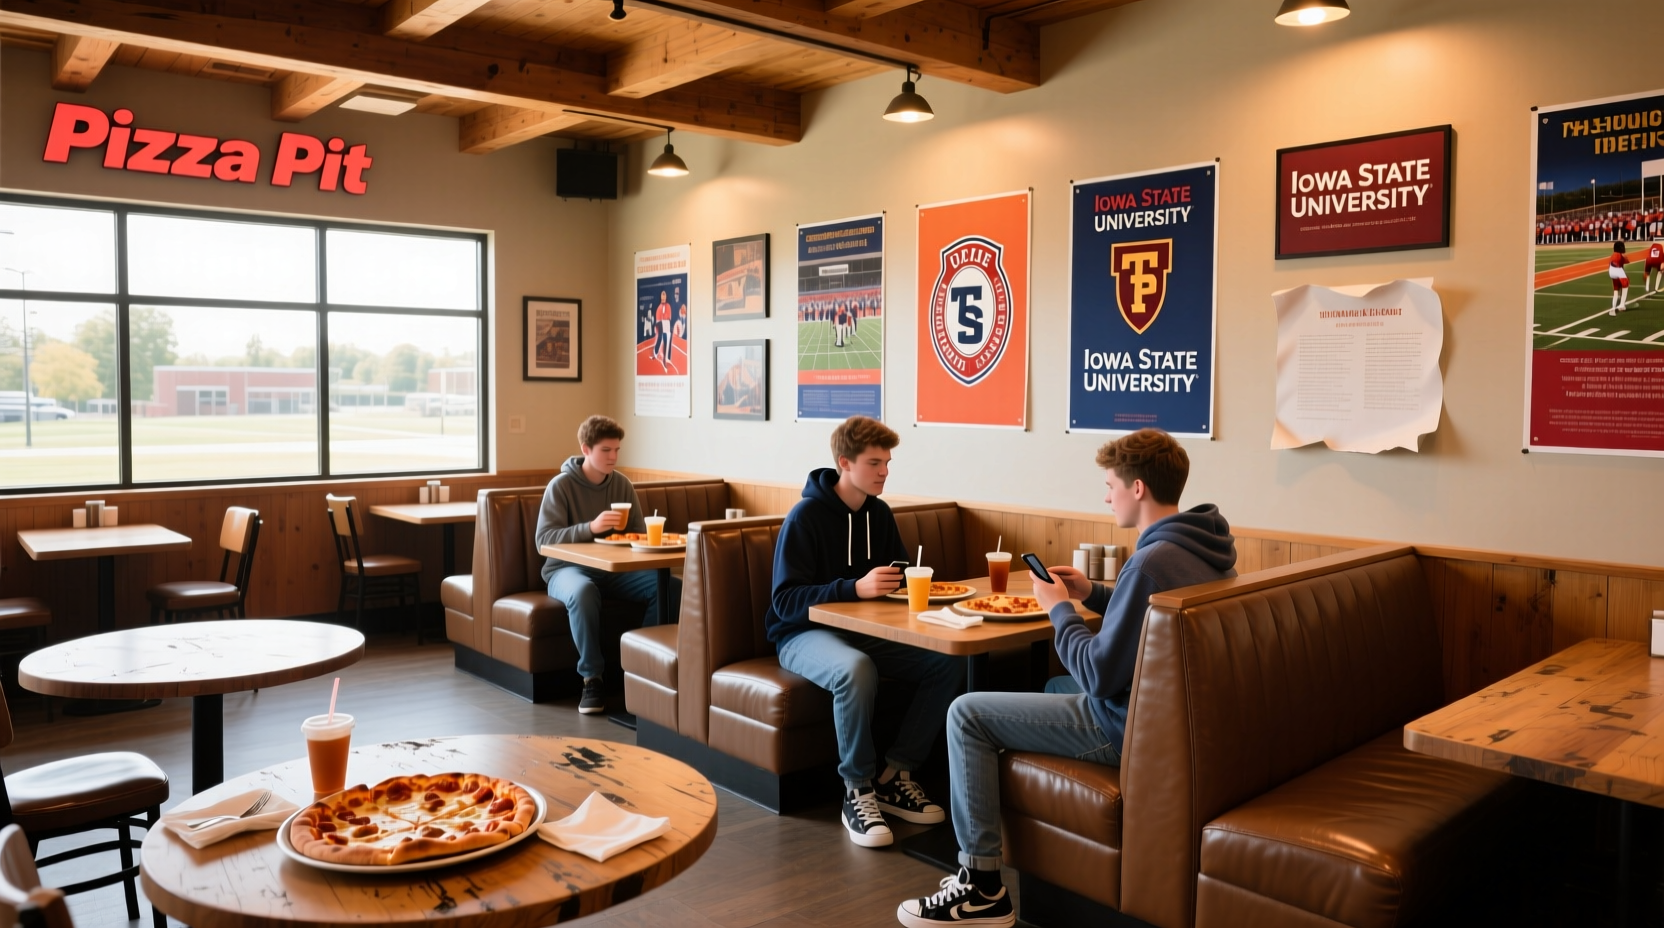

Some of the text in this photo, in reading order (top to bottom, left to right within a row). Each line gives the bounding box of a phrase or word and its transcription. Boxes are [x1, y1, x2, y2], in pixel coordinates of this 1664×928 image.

[43, 102, 373, 195] Pizza Pit
[1291, 158, 1431, 195] IOWA STATE
[1094, 185, 1191, 213] IOWA STATE
[1290, 183, 1430, 218] UNIVERSITY
[1094, 205, 1192, 233] UNIVERSITY
[1084, 348, 1198, 370] IOWA STATE
[1083, 372, 1196, 393] UNIVERSITY
